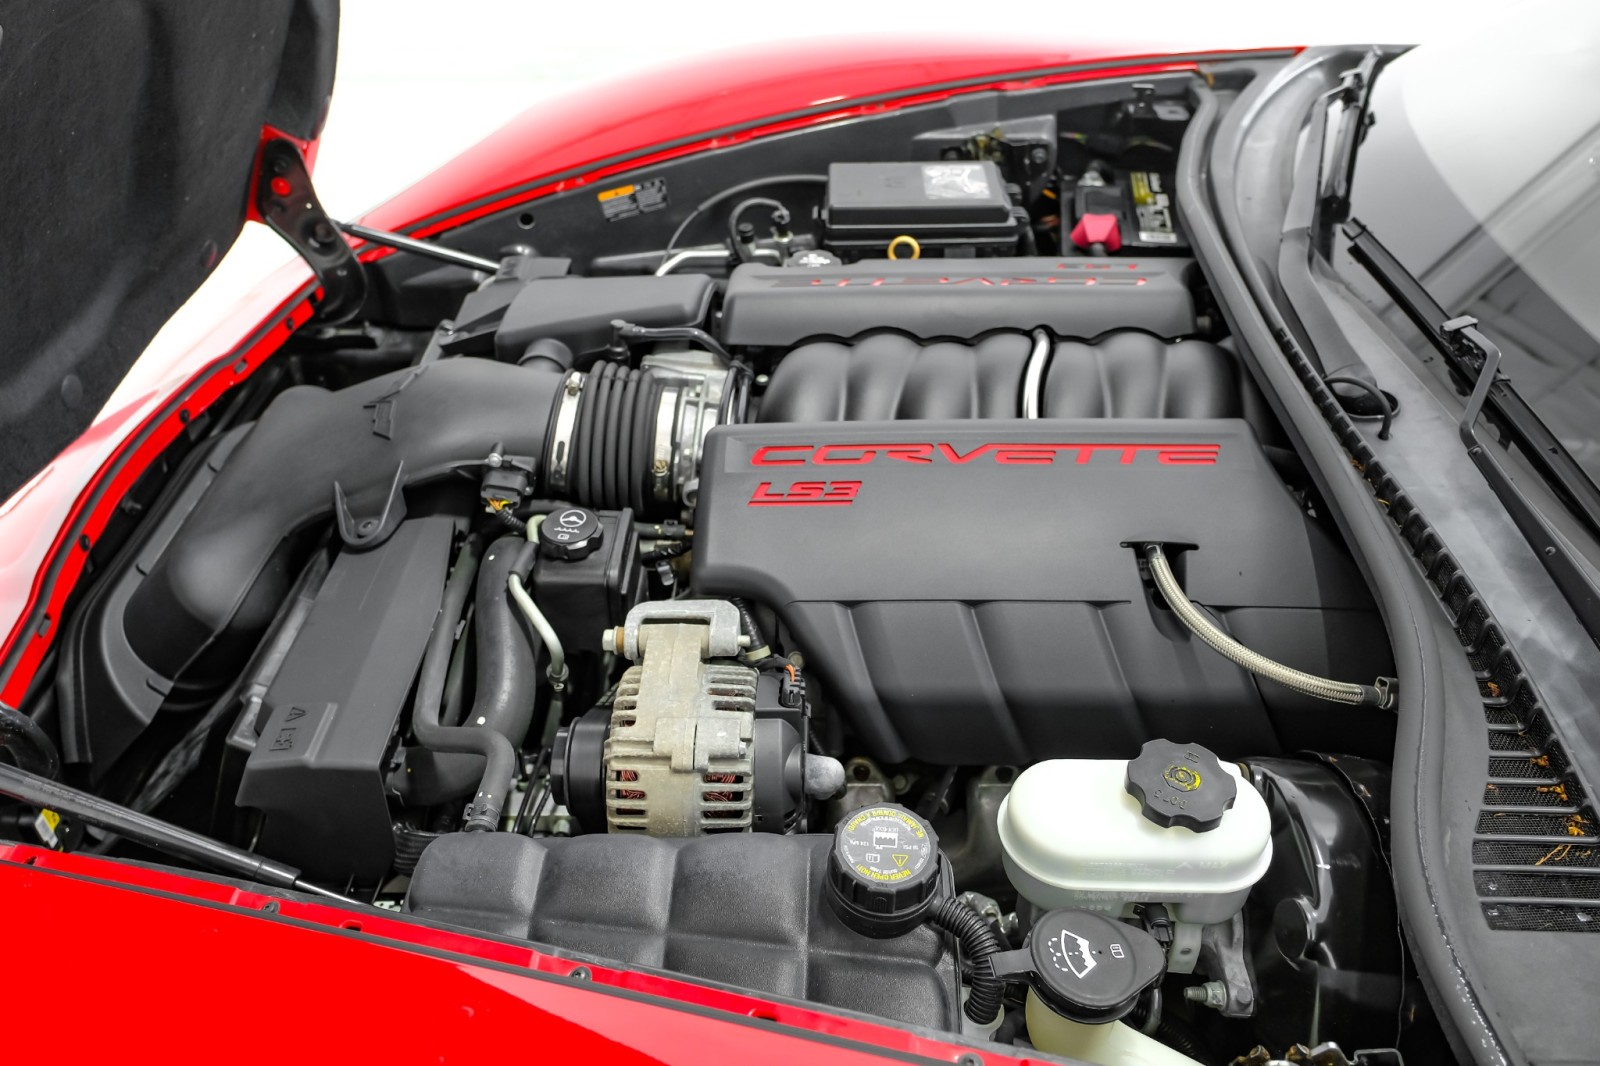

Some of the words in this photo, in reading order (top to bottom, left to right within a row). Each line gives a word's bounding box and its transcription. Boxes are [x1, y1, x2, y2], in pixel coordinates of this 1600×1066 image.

[750, 443, 1221, 466] CORVETTE
[748, 480, 863, 502] LS3
[871, 872, 889, 880] OPEN
[890, 869, 911, 880] NEVER
